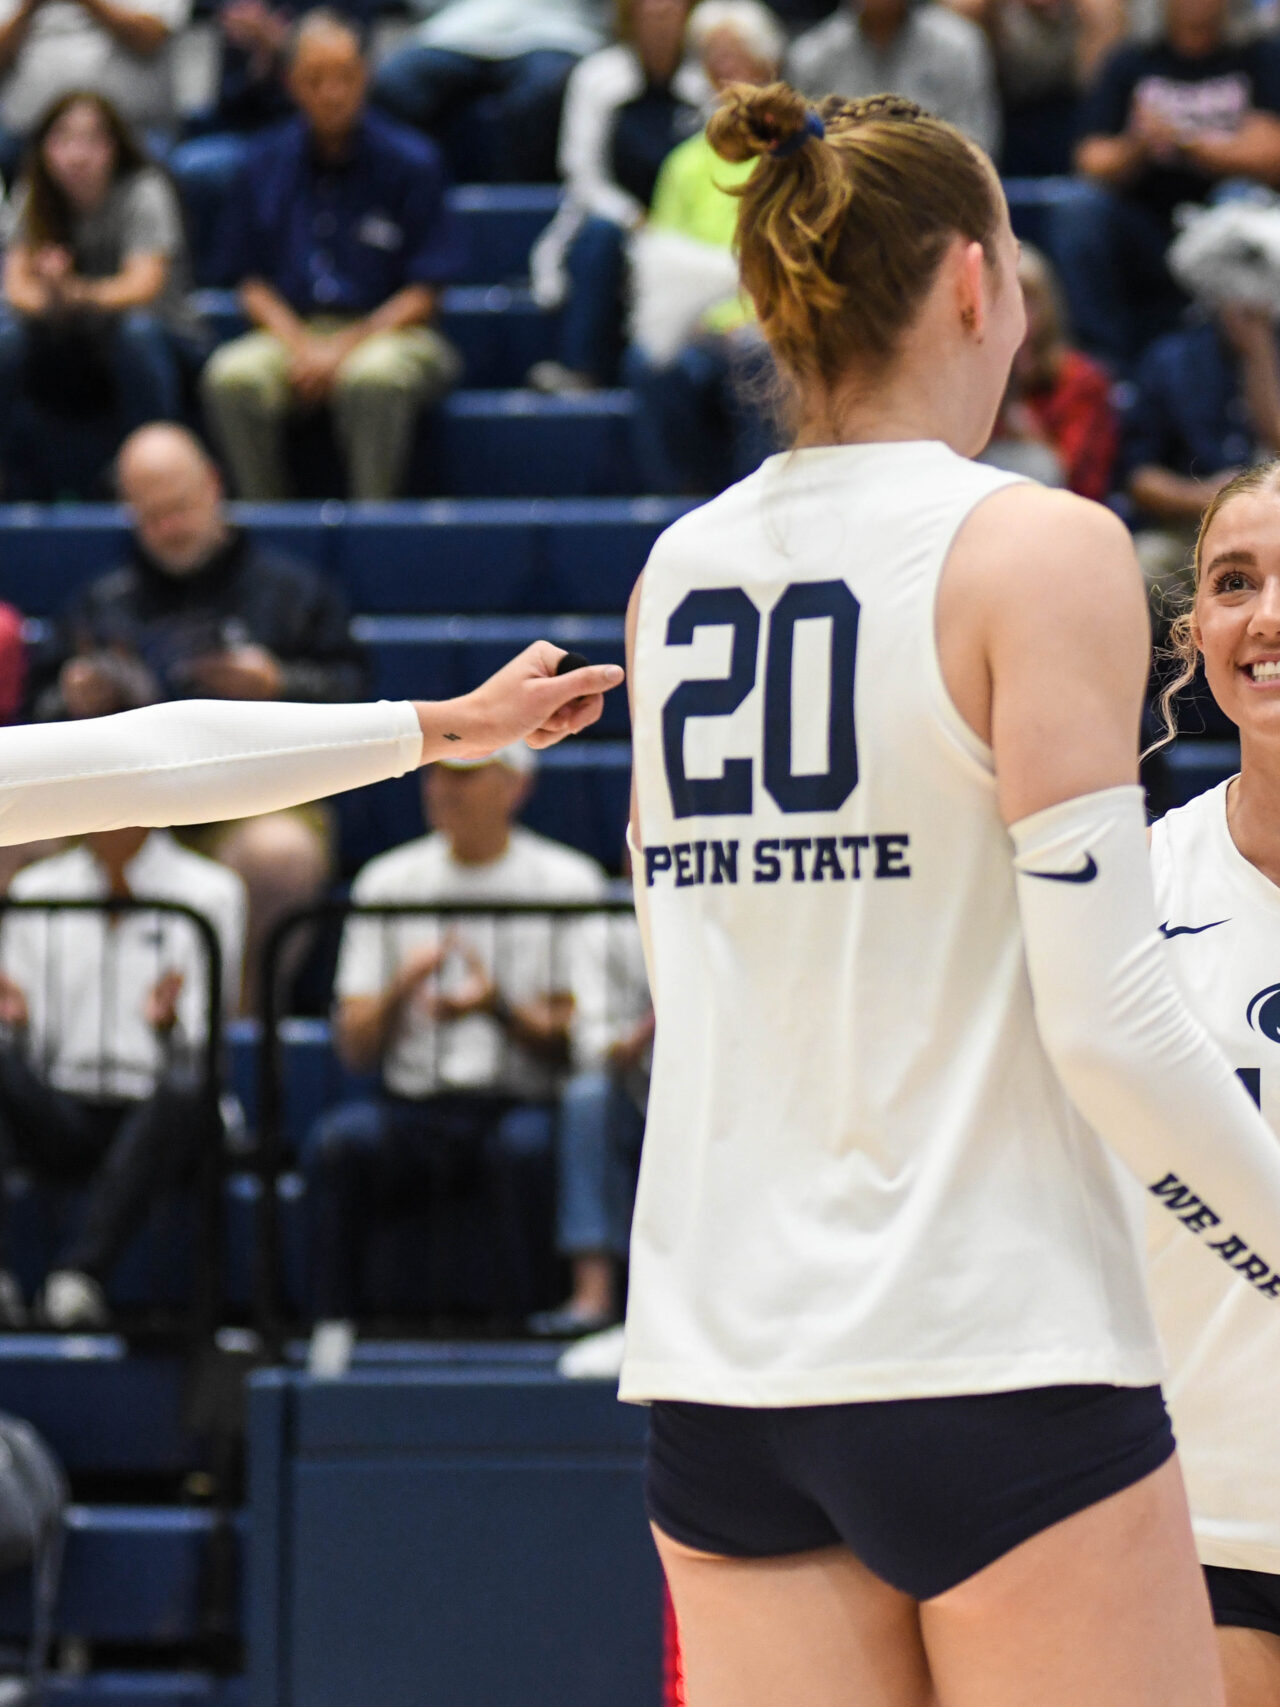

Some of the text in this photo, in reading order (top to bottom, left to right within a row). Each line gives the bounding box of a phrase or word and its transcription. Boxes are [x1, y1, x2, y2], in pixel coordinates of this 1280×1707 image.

[661, 578, 861, 819] 20
[753, 833, 911, 883] STATE
[1148, 1173, 1221, 1234] WE
